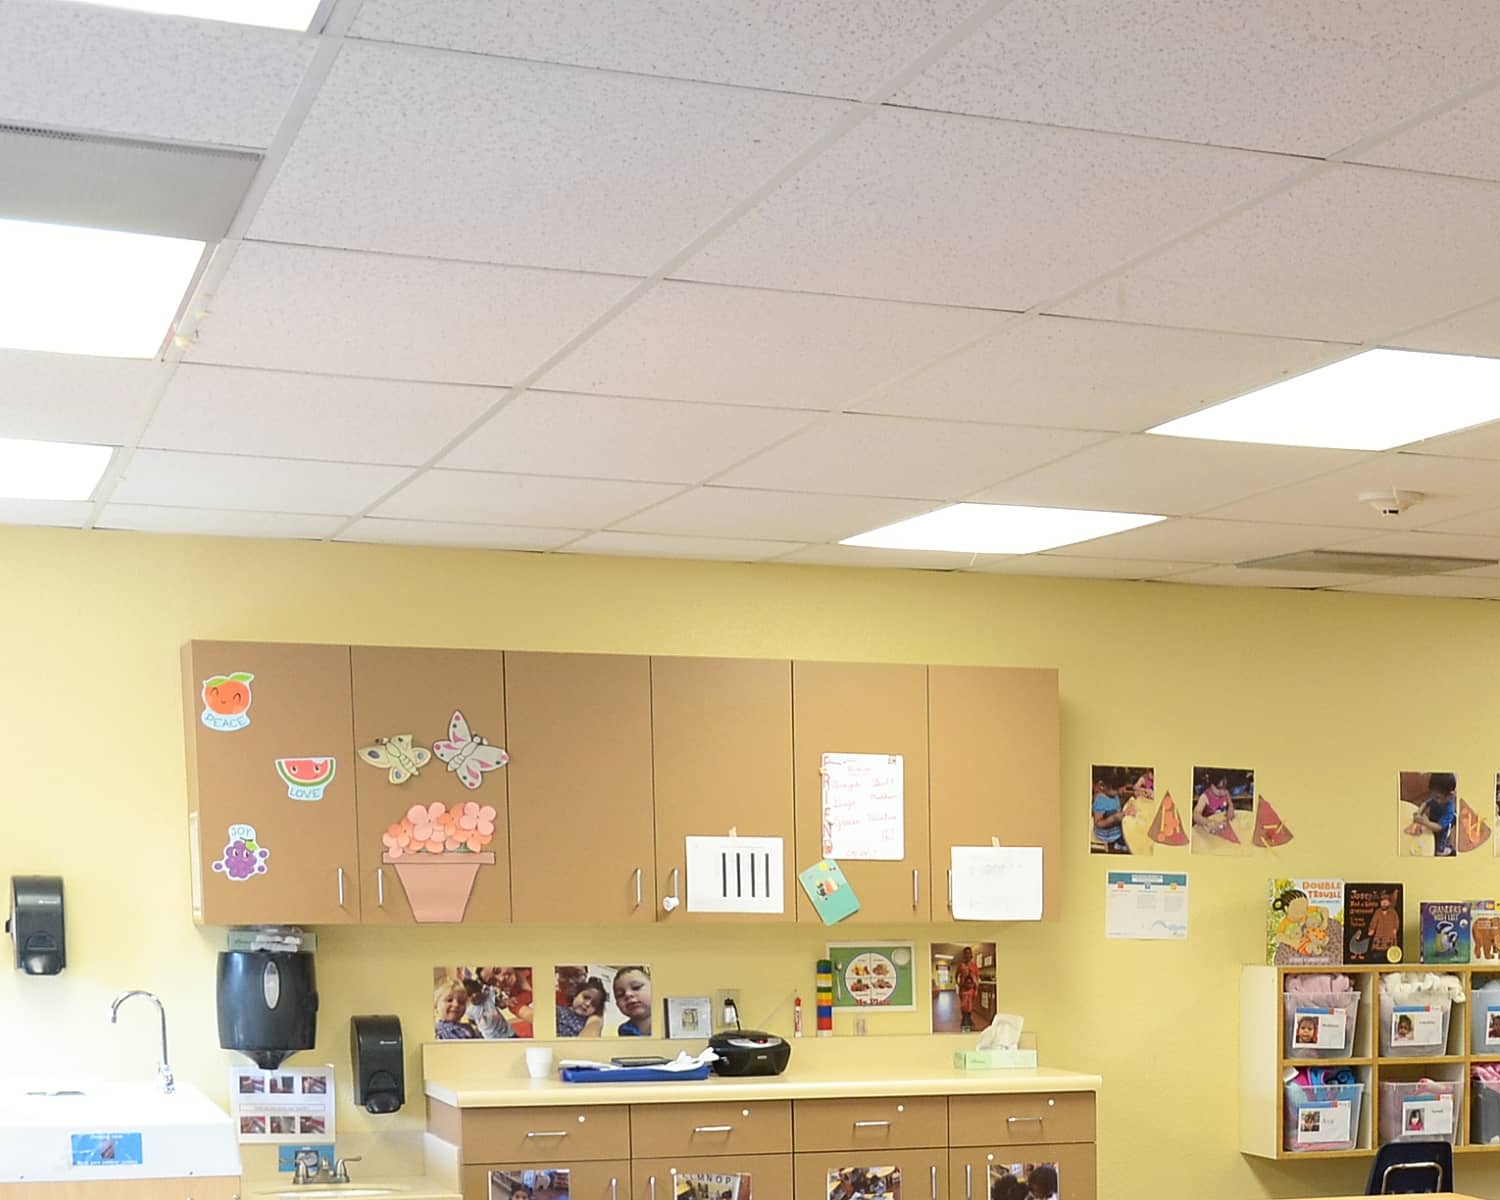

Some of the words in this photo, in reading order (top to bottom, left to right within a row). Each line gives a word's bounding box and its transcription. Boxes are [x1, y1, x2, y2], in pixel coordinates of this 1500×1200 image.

[204, 712, 248, 728] PEACE
[290, 786, 321, 799] LOVE
[231, 826, 252, 837] JOY
